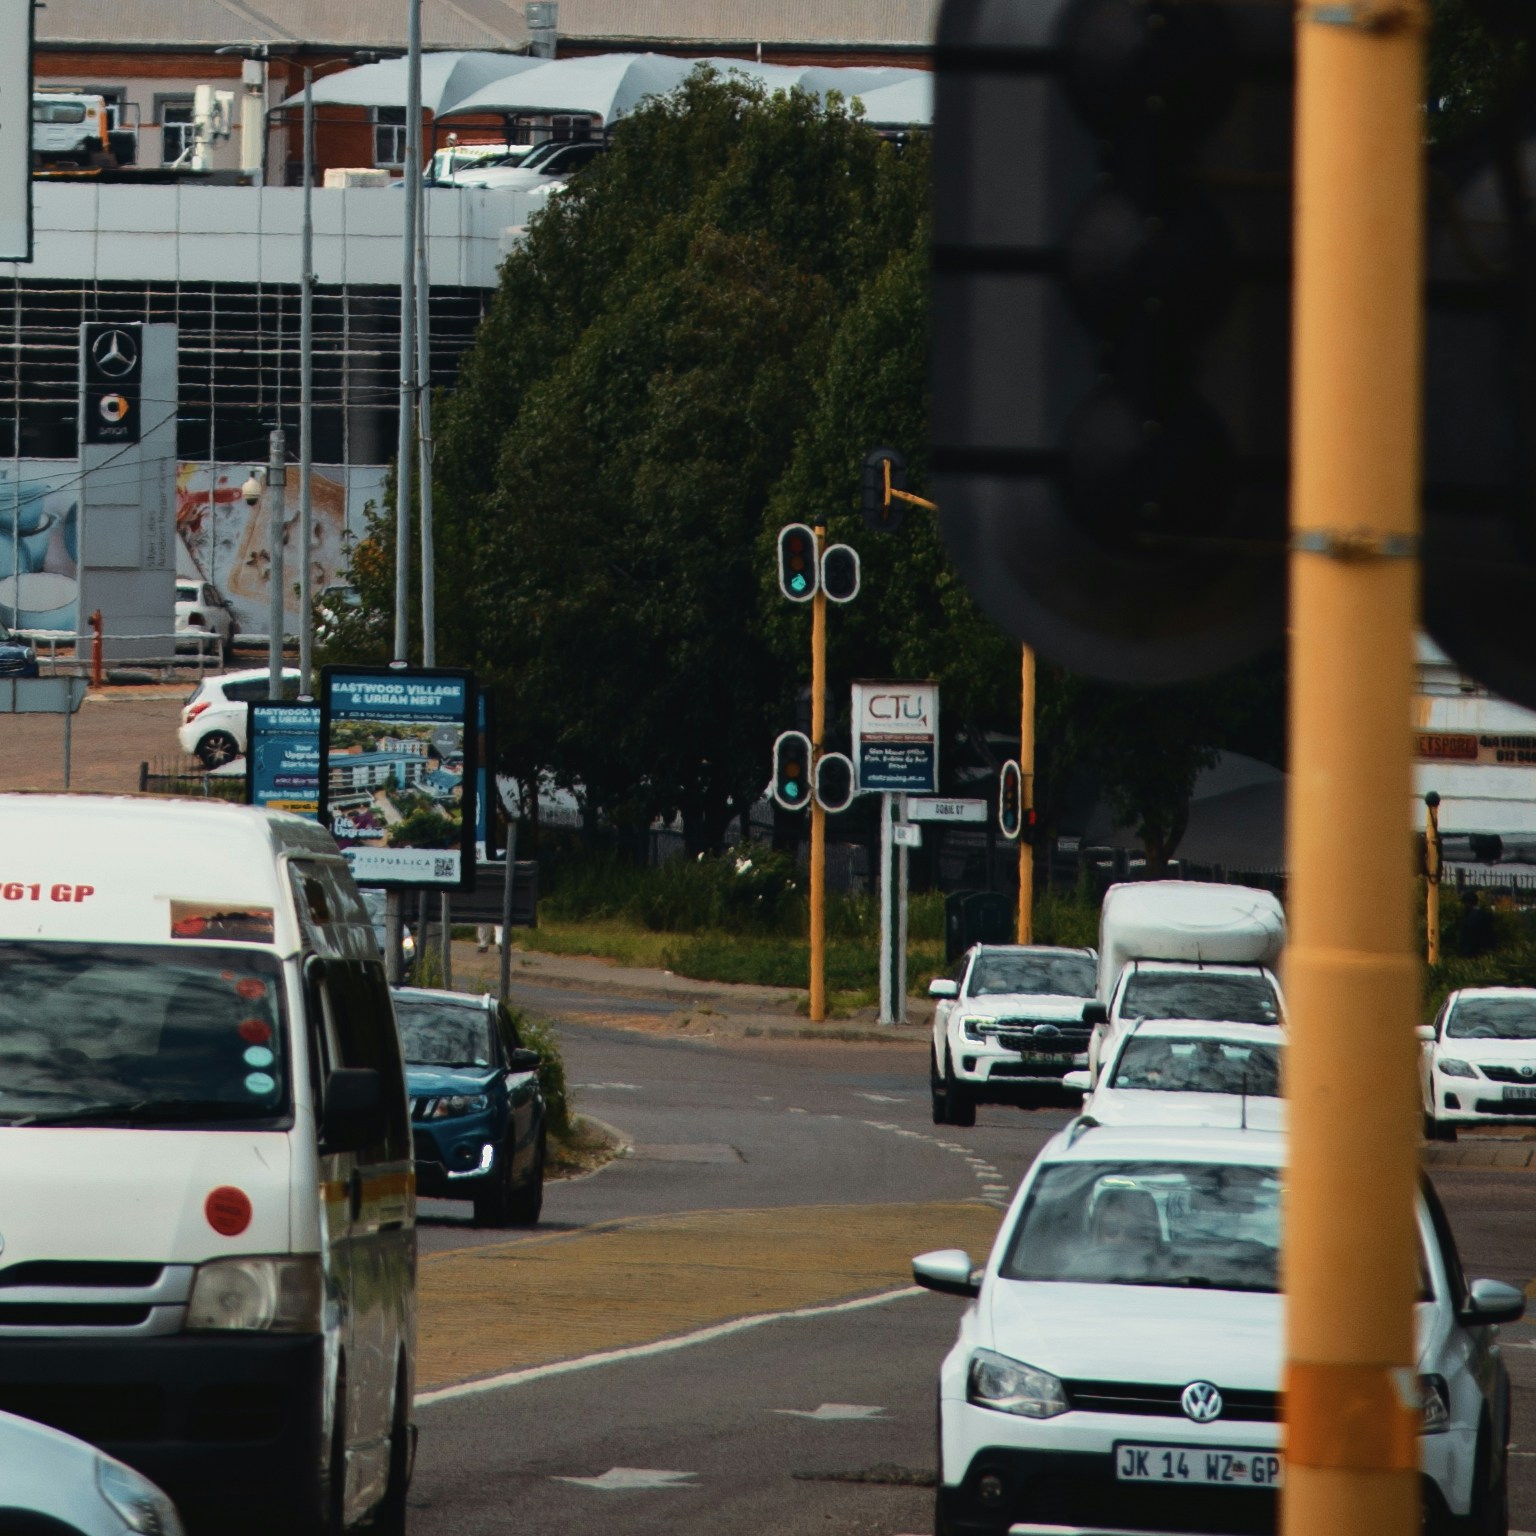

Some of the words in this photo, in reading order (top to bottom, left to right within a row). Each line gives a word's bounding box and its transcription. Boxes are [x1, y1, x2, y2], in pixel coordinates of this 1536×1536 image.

[331, 682, 404, 695] EASTWOOD
[406, 685, 460, 696] VILLAGE
[351, 694, 362, 703] &
[364, 694, 409, 705] URBAN
[410, 695, 443, 706] NEST
[869, 694, 922, 720] CTU
[50, 884, 95, 903] GP
[1122, 1448, 1150, 1477] JK
[1161, 1451, 1190, 1479] 14
[1206, 1453, 1234, 1482] WZ
[1251, 1455, 1280, 1483] GP
